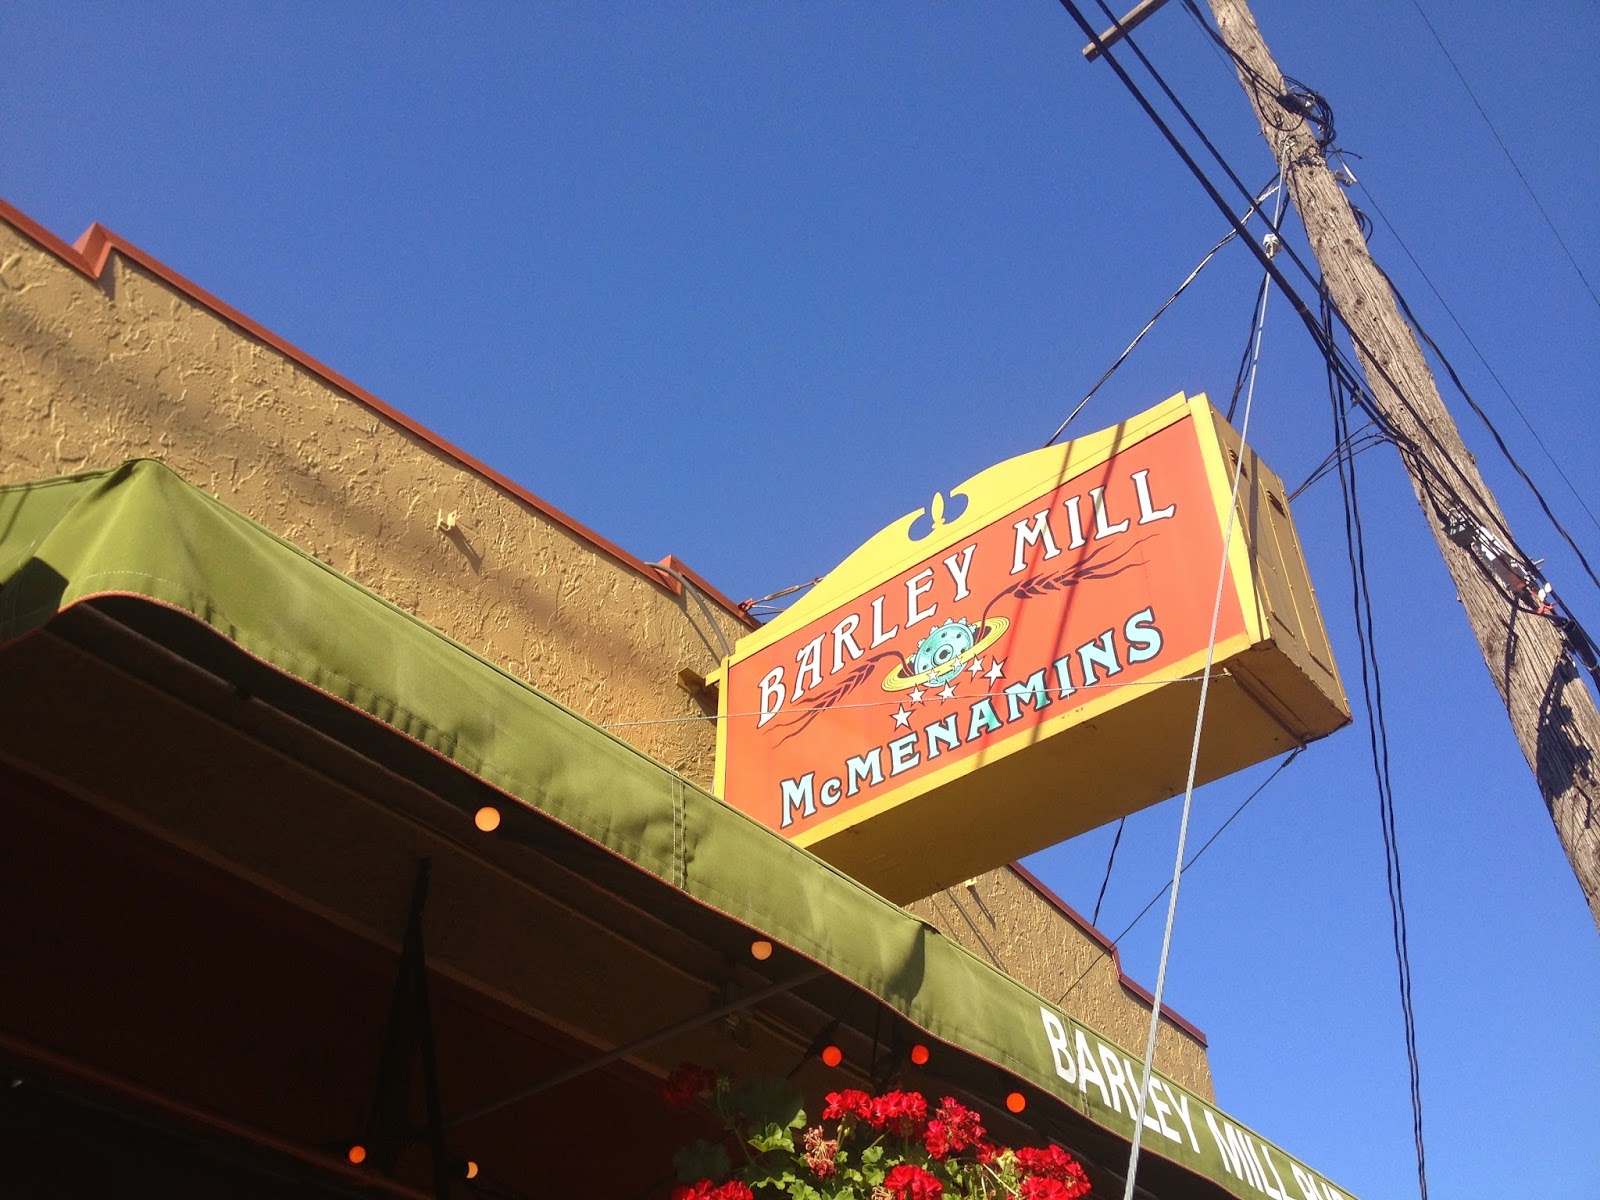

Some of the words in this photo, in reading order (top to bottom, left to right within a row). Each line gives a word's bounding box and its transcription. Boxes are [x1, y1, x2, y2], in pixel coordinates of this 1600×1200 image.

[756, 543, 979, 729] BARLEY
[1010, 468, 1176, 576] MILL
[779, 607, 1164, 829] McMENAMINS
[1040, 1006, 1201, 1155] BARLEY
[1203, 1109, 1297, 1200] MILL
